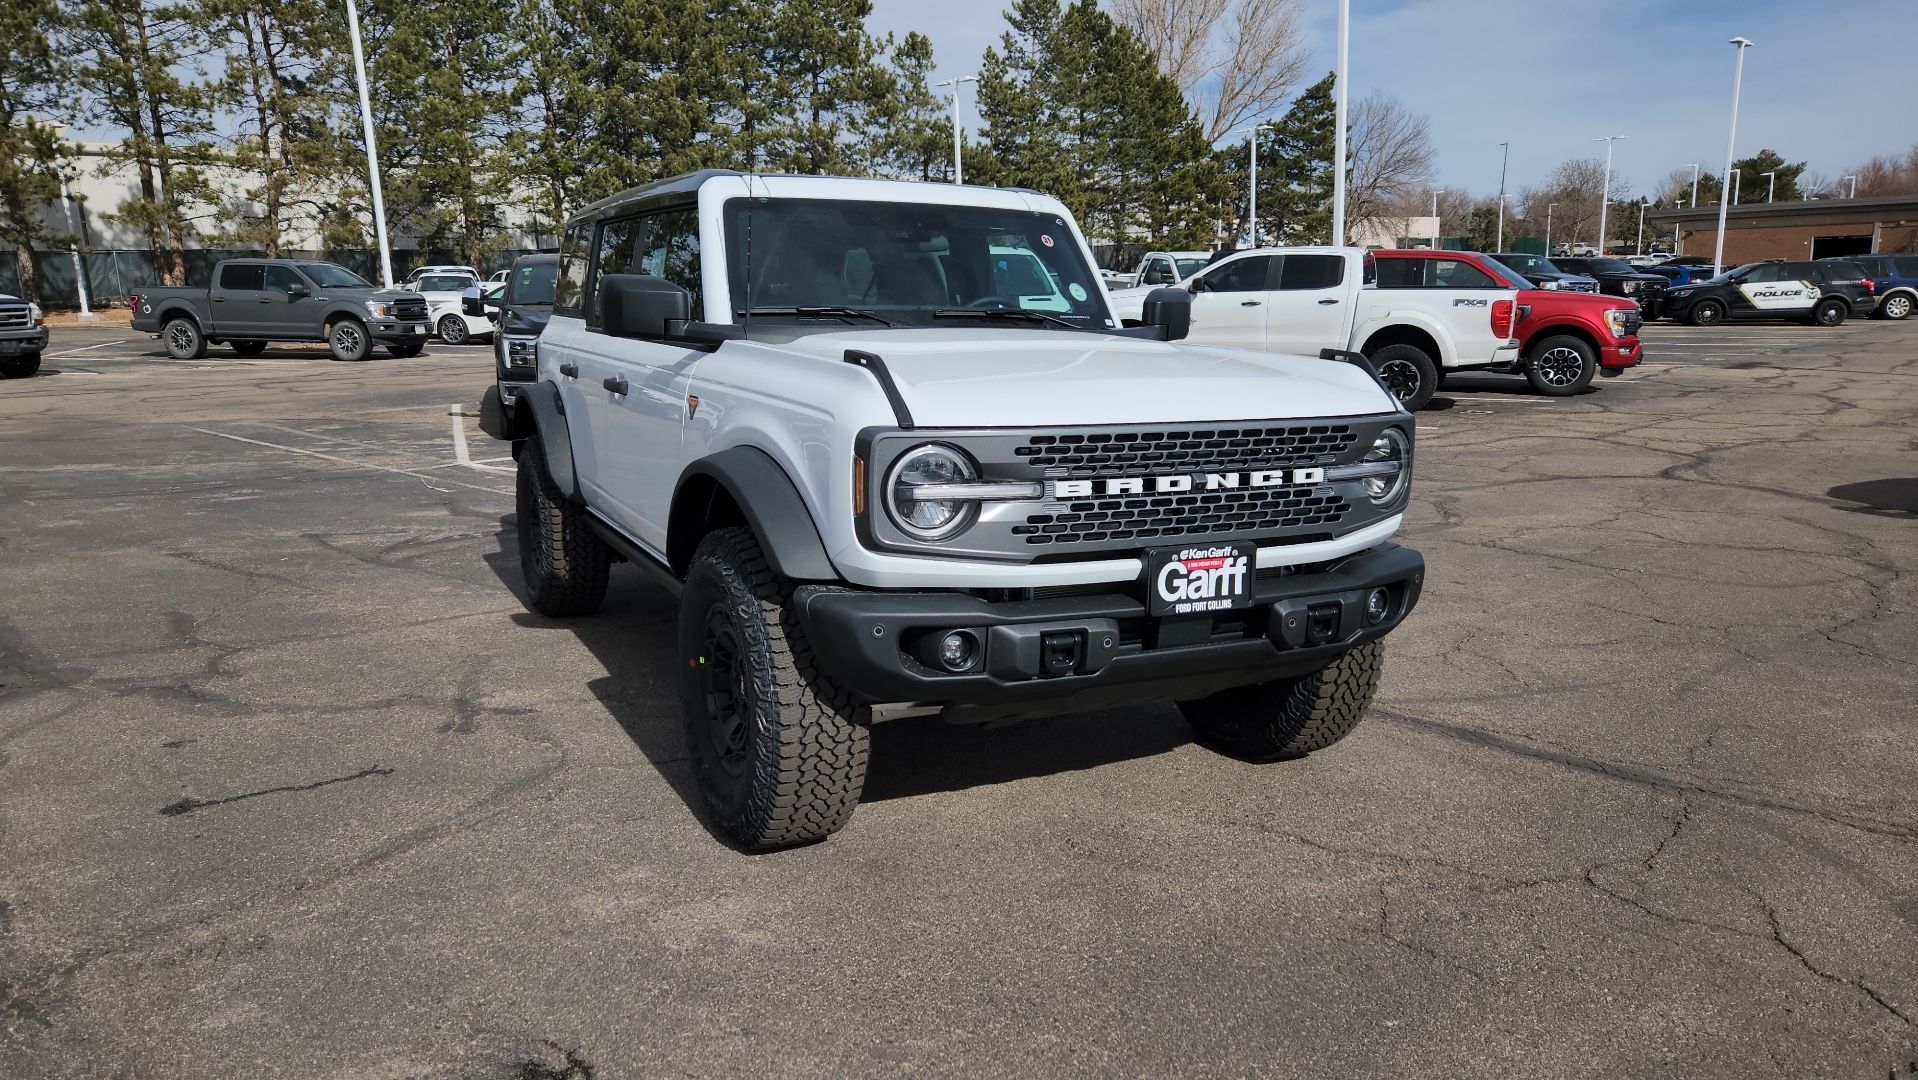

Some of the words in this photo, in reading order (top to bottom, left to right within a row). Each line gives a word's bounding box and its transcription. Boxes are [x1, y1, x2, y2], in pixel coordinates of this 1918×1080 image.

[1753, 289, 1803, 298] POLICE
[1453, 299, 1487, 307] FX4
[1054, 467, 1324, 498] BRONCO
[1189, 548, 1208, 559] Ken
[1208, 546, 1232, 557] Garff
[1157, 556, 1248, 602] Garff
[1175, 603, 1191, 613] FORD
[1192, 601, 1207, 611] FORT
[1208, 599, 1232, 610] COLLINS
